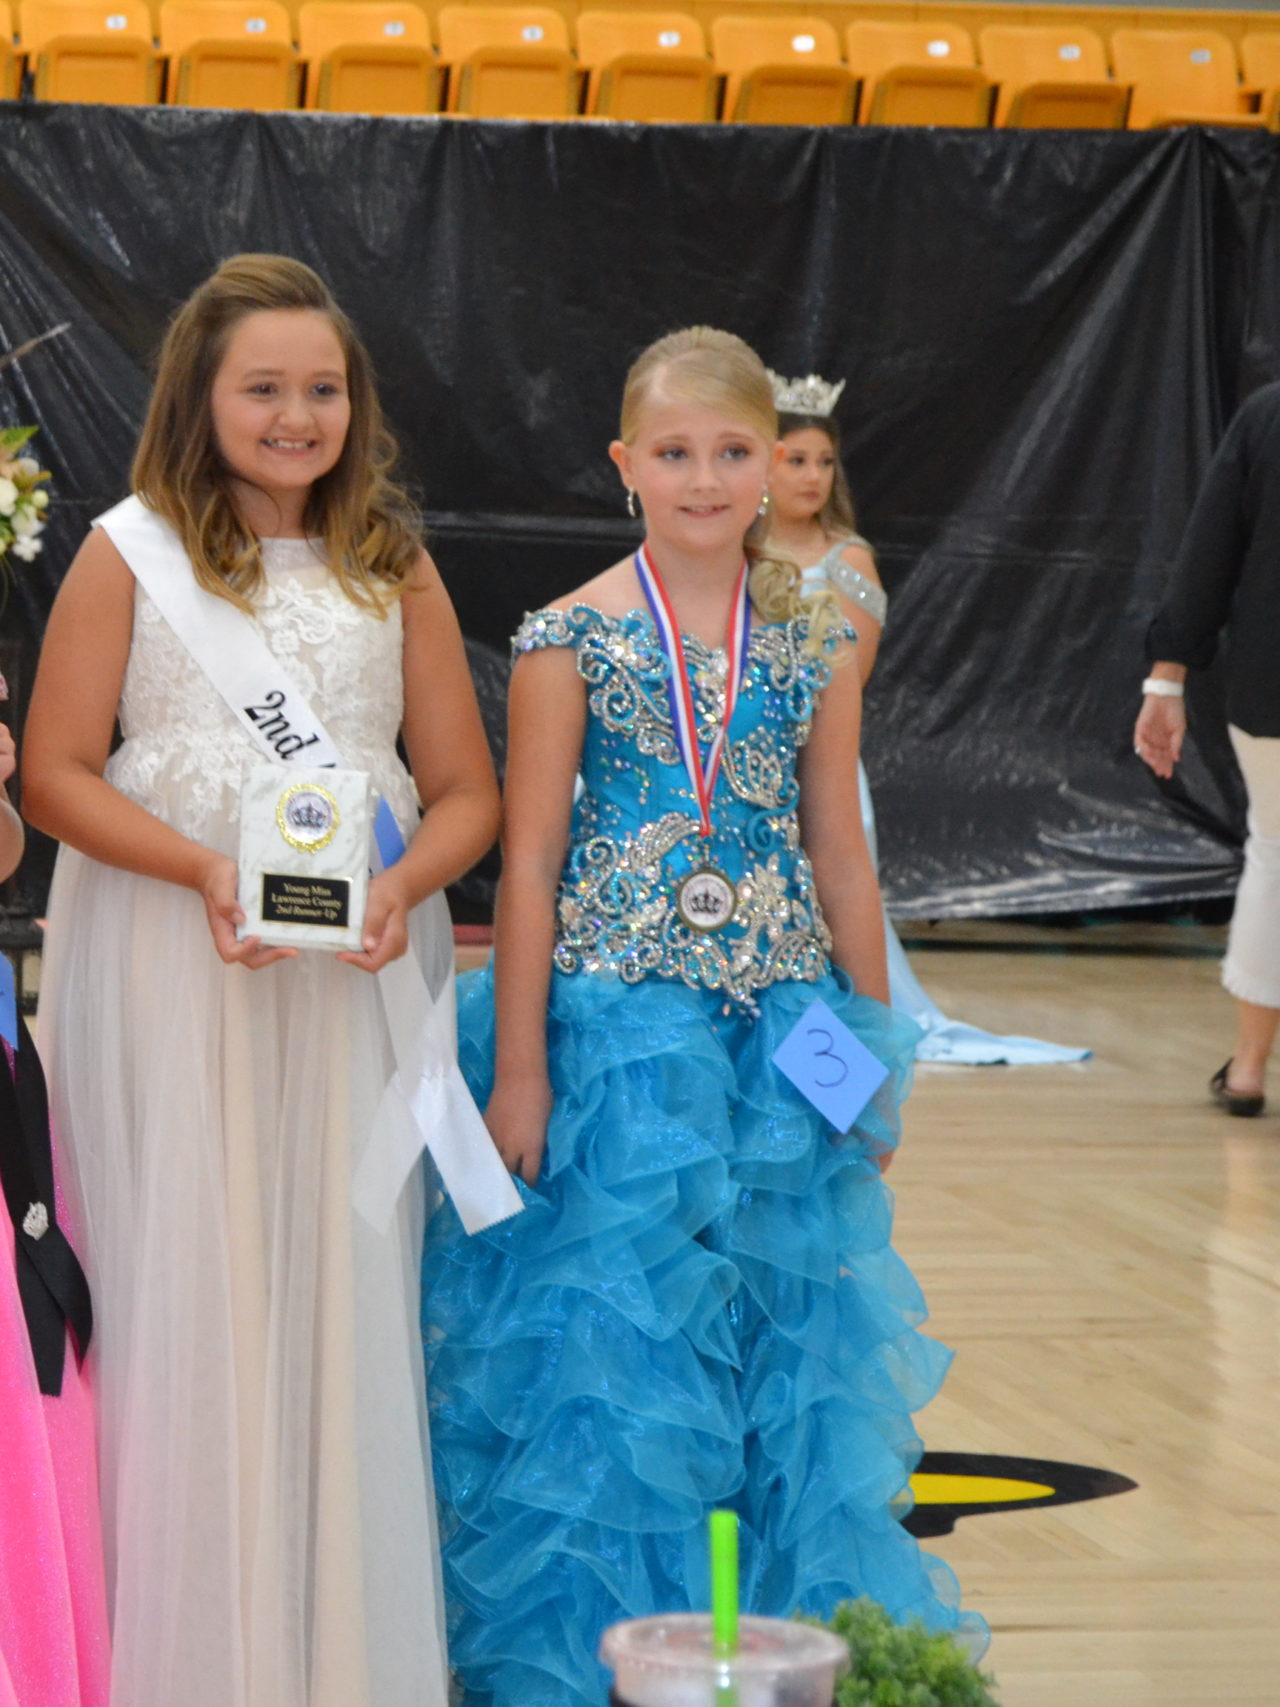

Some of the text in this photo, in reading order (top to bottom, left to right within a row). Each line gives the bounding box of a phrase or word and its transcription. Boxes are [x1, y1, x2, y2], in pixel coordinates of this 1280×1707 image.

[243, 690, 320, 760] 2nd
[271, 892, 343, 910] Lawrence County
[283, 882, 332, 897] Young Miss
[806, 1028, 848, 1088] 3
